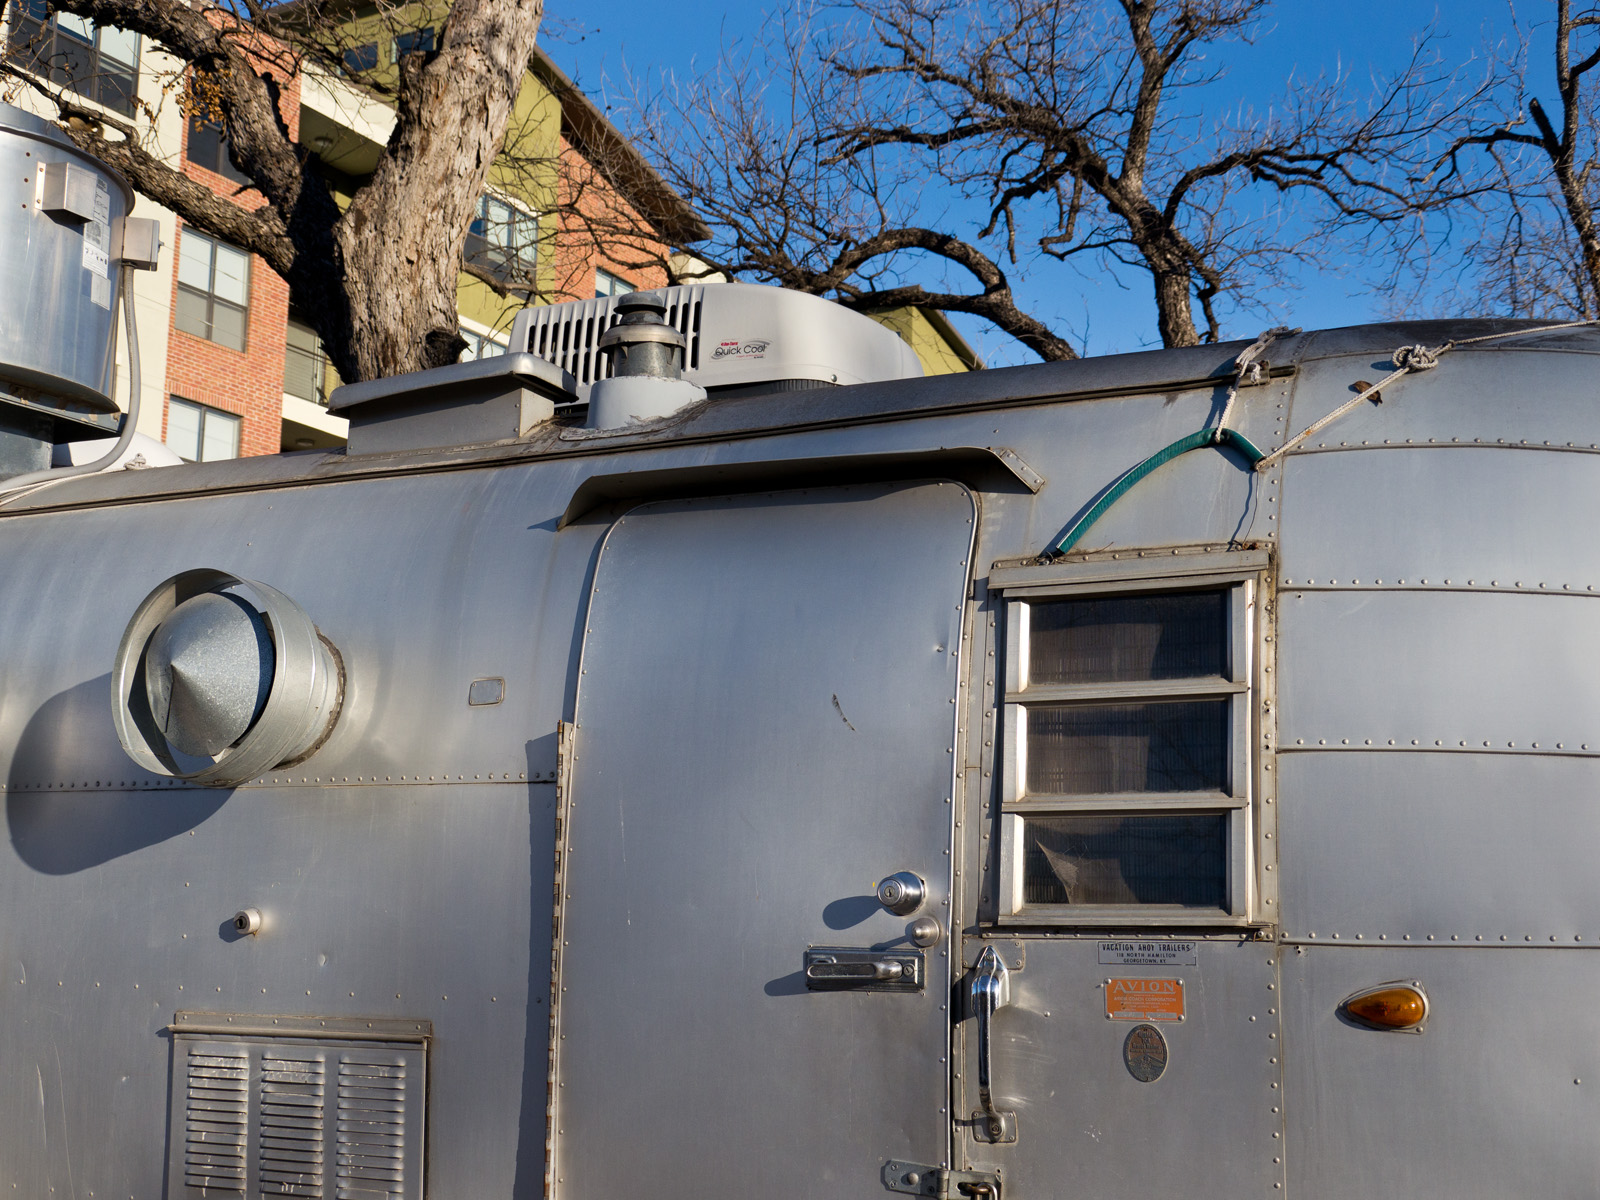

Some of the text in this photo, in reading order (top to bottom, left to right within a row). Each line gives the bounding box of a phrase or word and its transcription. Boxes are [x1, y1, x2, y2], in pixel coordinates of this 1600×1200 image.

[715, 344, 766, 355] Quick Cool
[1102, 943, 1190, 952] VACATION AHOY TRAILERS
[1113, 981, 1174, 994] AVION
